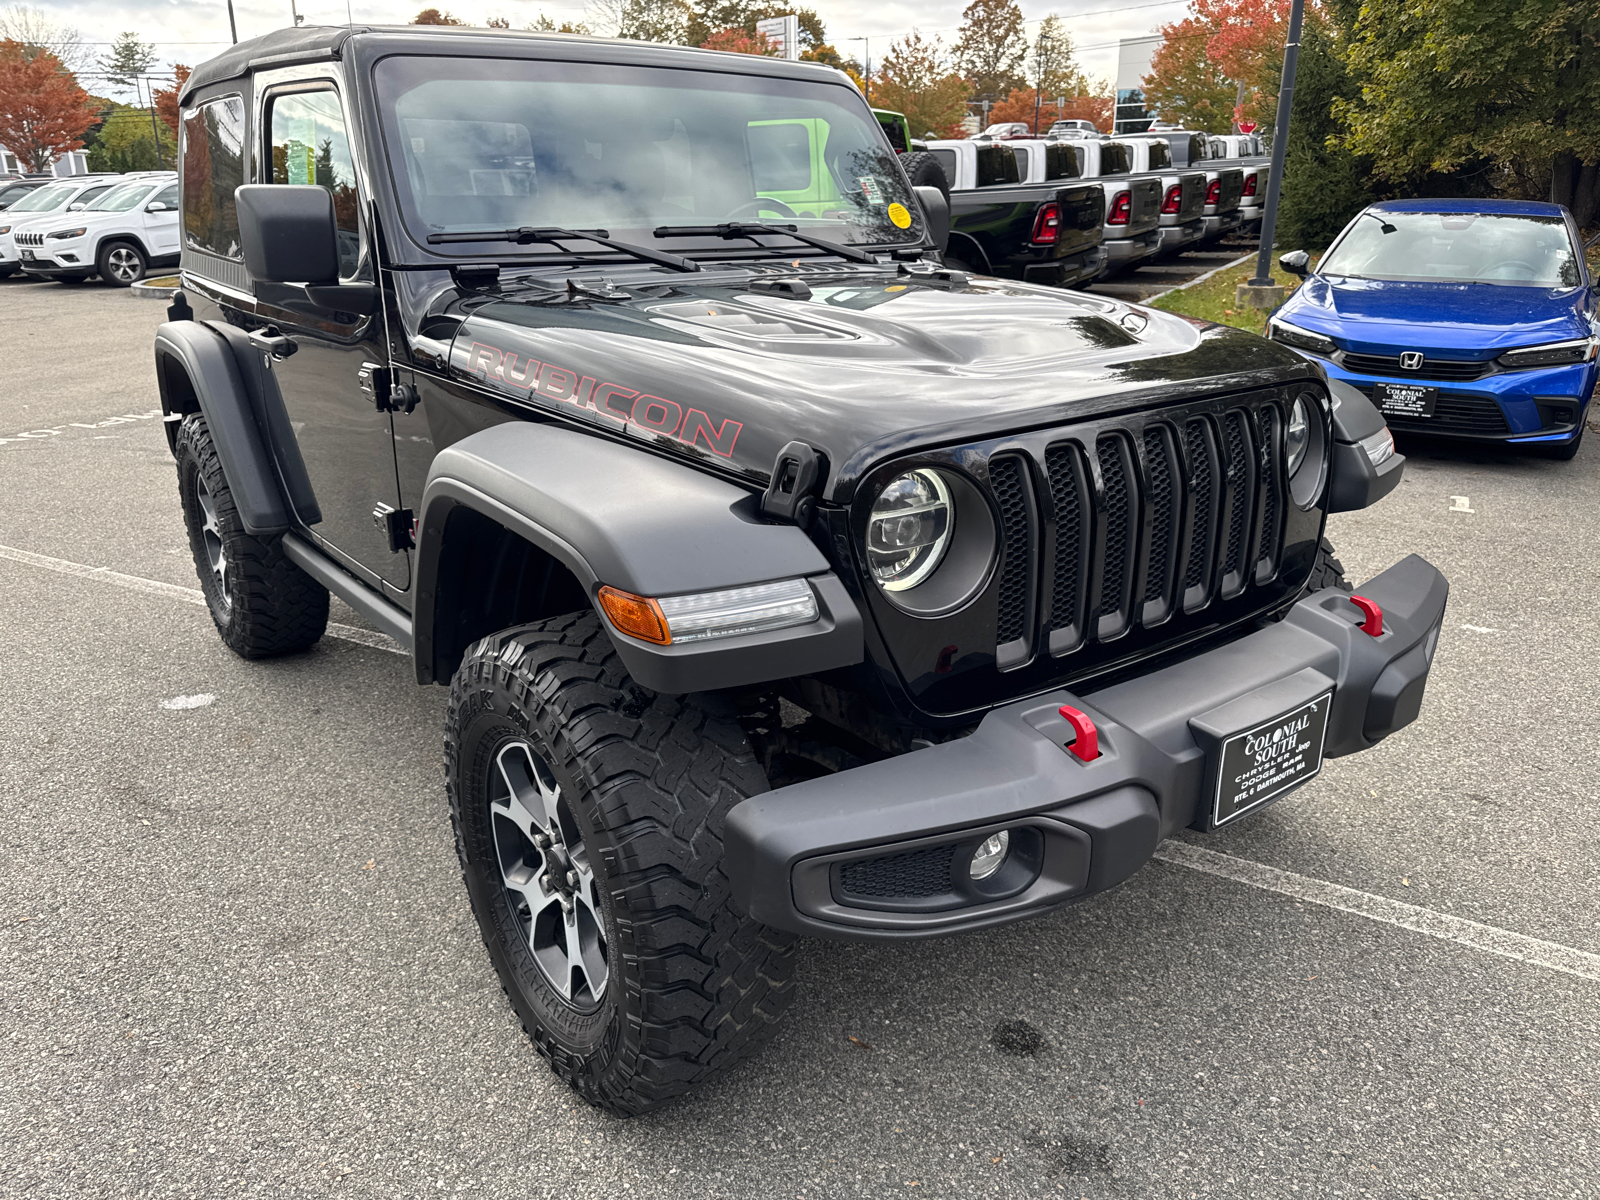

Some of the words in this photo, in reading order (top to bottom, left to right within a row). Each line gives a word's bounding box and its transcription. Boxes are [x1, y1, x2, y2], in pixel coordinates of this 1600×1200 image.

[466, 342, 744, 458] RUBICON
[1244, 714, 1310, 756] COLONIAL
[1254, 733, 1299, 766] SOUTH
[1234, 752, 1291, 783] CHRYSLER
[1296, 741, 1310, 752] Jeep
[1234, 791, 1248, 803] RTE.
[1256, 766, 1296, 792] DARTMOUTH,
[1296, 761, 1305, 770] MA
[1240, 767, 1277, 790] DODGE
[1282, 754, 1303, 769] RAM
